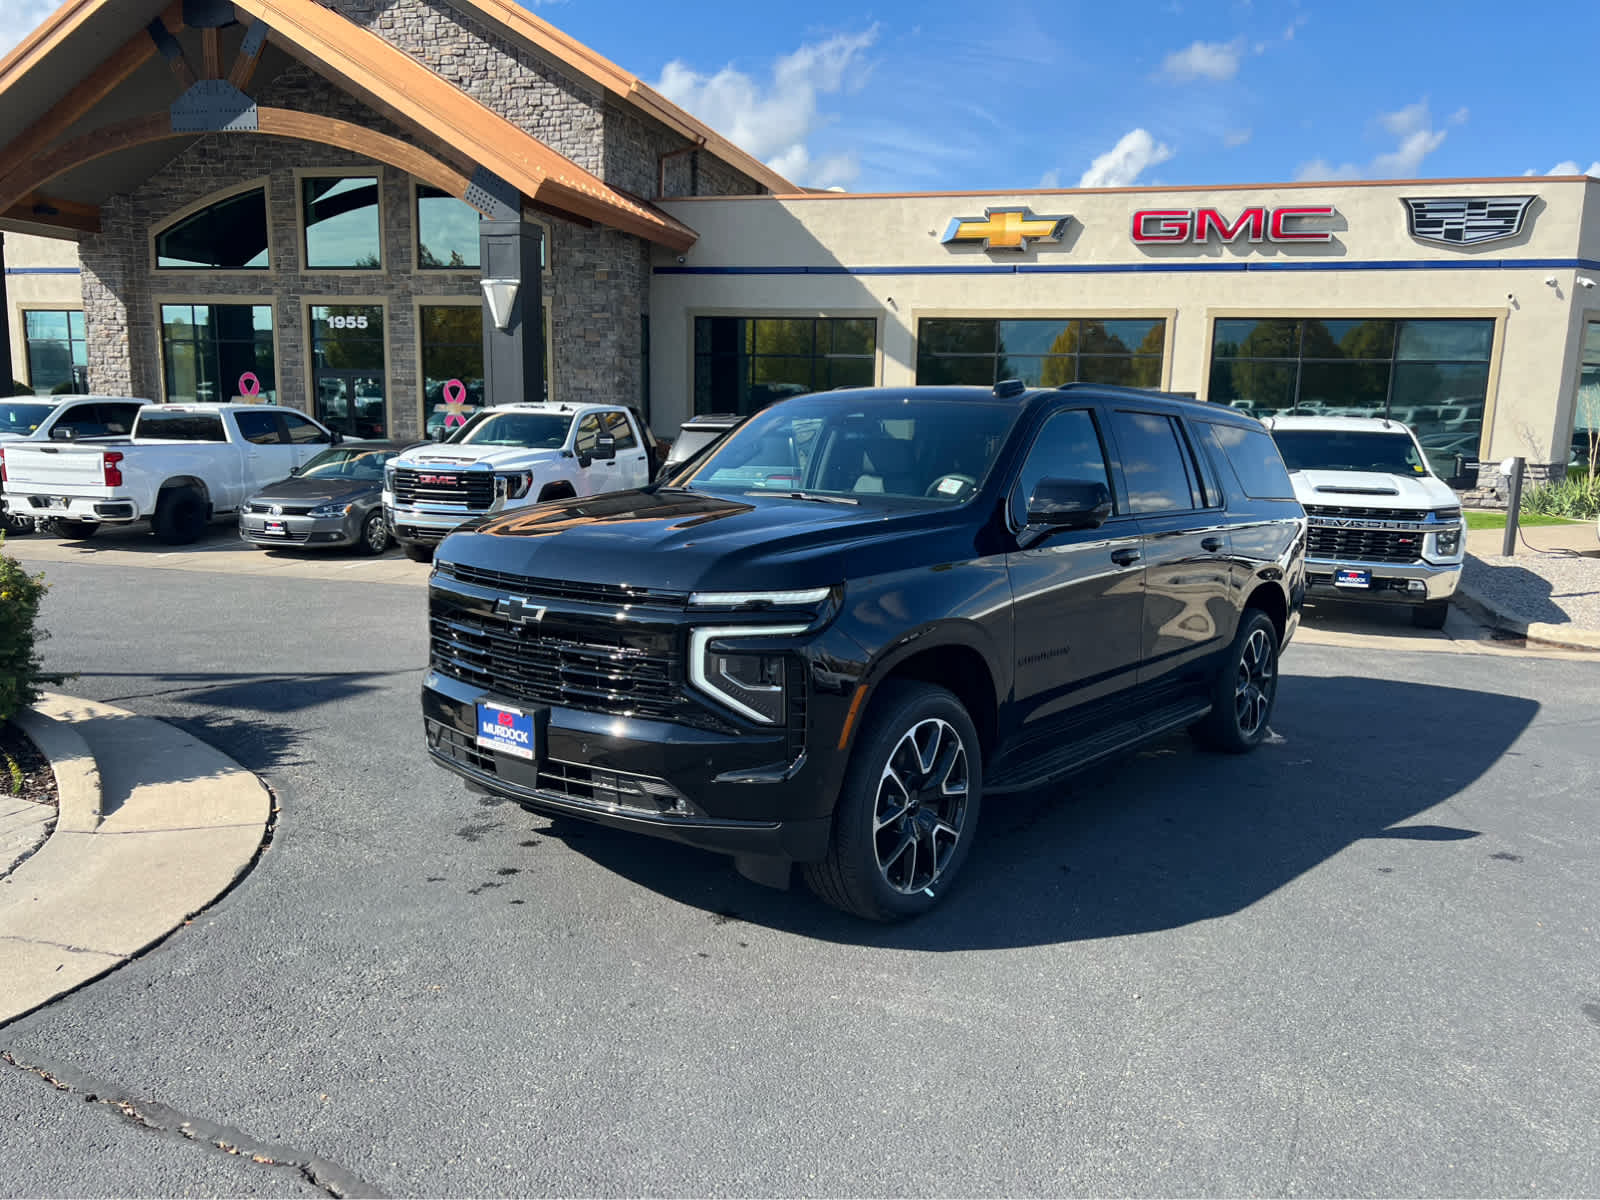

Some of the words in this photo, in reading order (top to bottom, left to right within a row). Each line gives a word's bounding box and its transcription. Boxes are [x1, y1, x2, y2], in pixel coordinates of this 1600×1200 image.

[1130, 205, 1335, 244] GMC
[327, 316, 368, 328] 1955
[419, 475, 456, 485] GMC
[483, 721, 528, 744] MURDOCK
